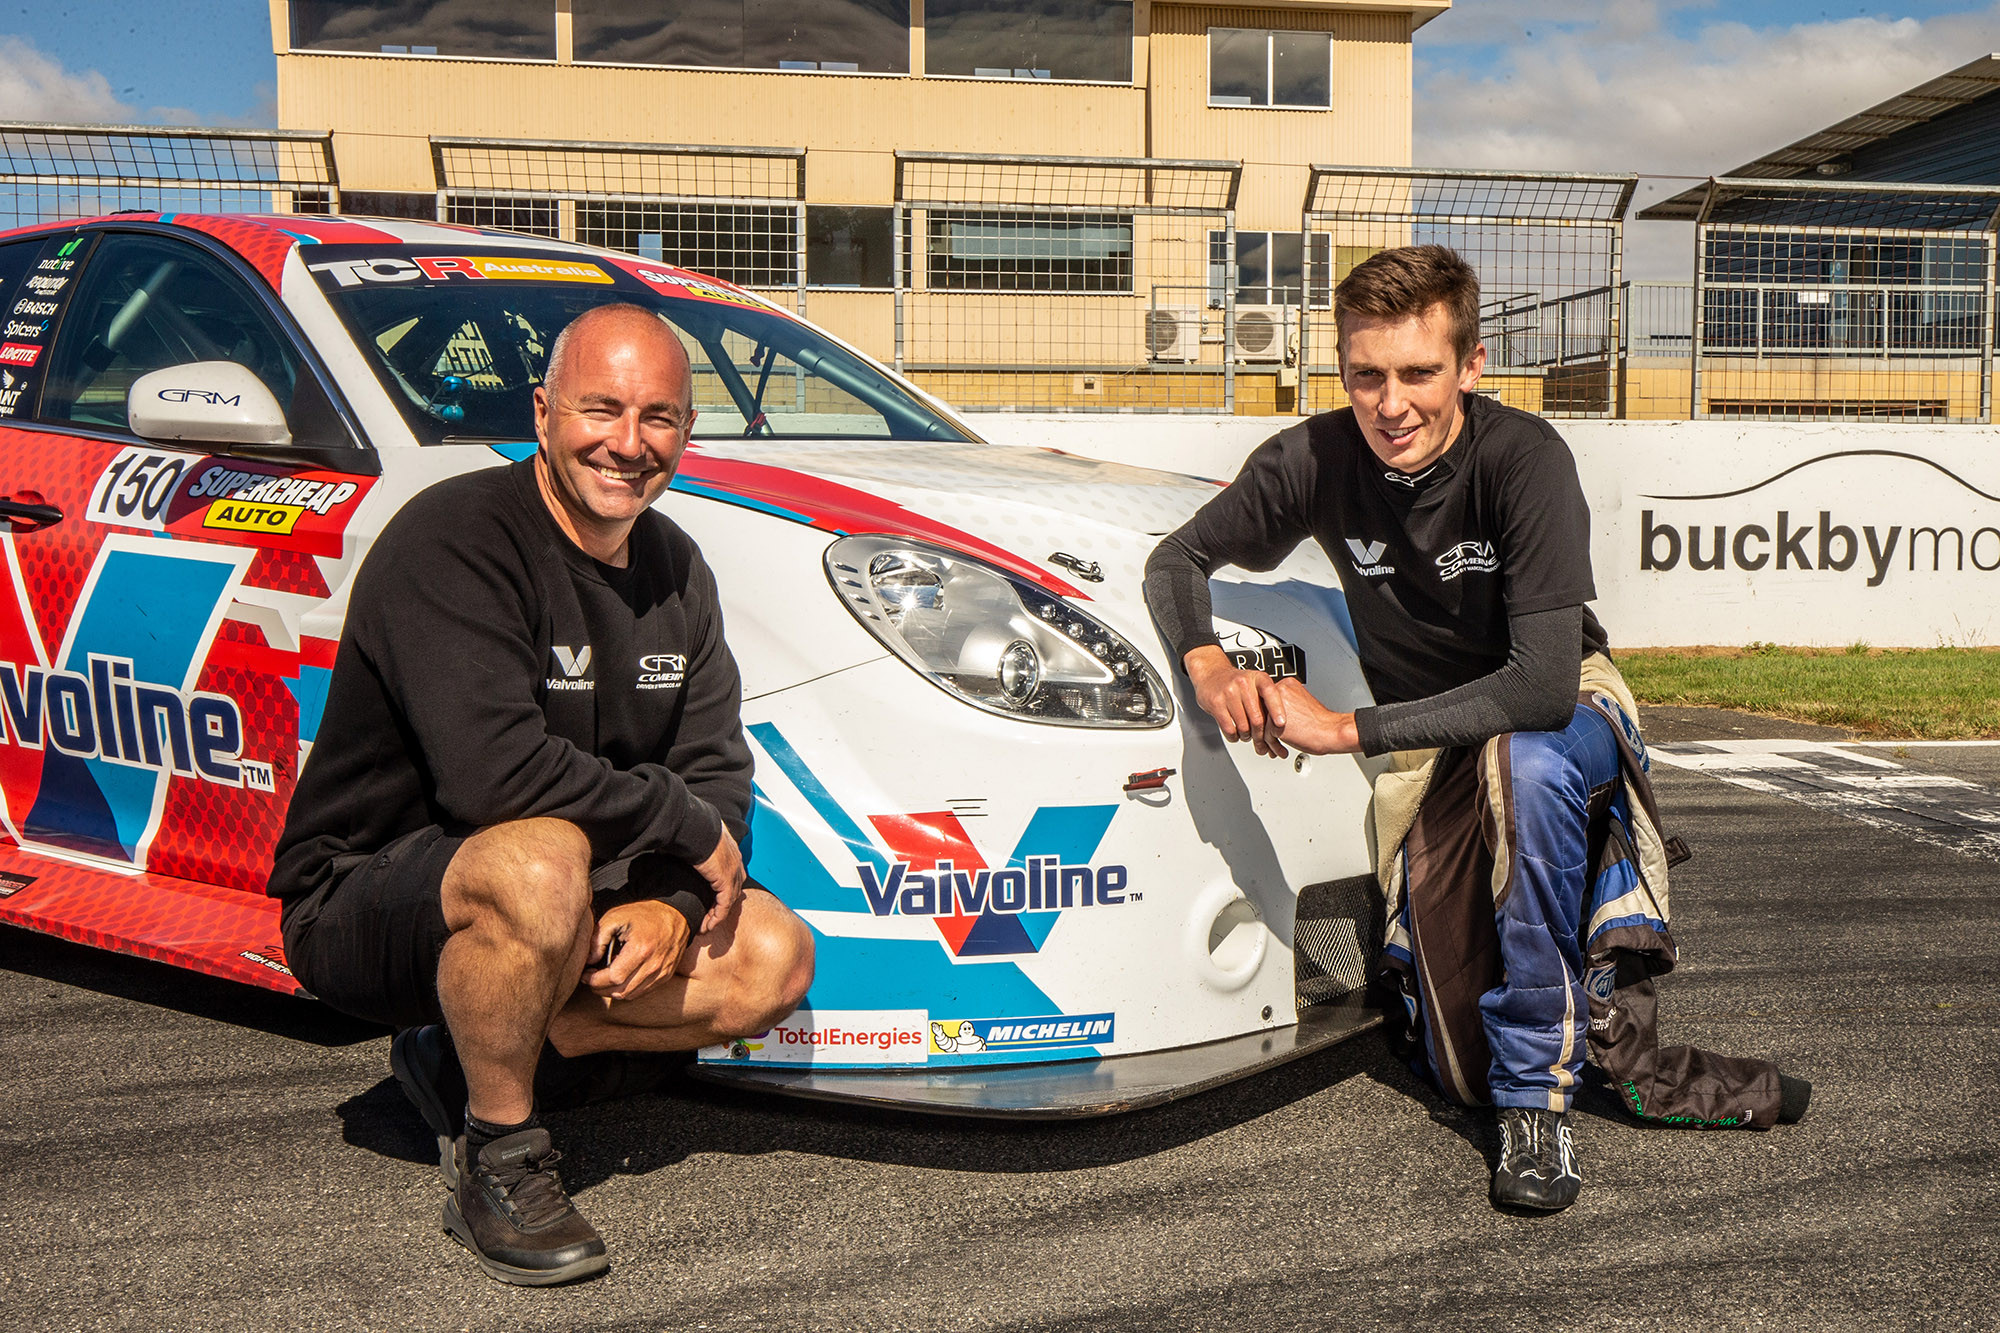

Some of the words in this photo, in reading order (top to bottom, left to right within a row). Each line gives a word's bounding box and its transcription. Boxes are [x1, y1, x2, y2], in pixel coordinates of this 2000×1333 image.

[308, 256, 488, 287] TCR
[484, 261, 601, 278] Australia
[23, 301, 59, 315] BOSCH
[702, 290, 762, 308] AUTO
[4, 320, 42, 338] Spicers
[0, 346, 38, 362] LOCTITE
[158, 388, 241, 407] GRM
[97, 453, 186, 521] 150
[188, 465, 359, 515] SUPERCHEAP
[216, 506, 288, 526] AUTO
[1435, 540, 1495, 567] GRM
[1640, 509, 2000, 587] buckbymo
[1439, 553, 1499, 577] COMBINE
[546, 678, 595, 690] Valvoline
[0, 657, 245, 788] voline
[856, 854, 1128, 917] Valvoline
[1129, 892, 1143, 902] TM
[240, 951, 268, 964] HIGH
[775, 1026, 923, 1050] TotalEnergies
[986, 1019, 1113, 1042] MICHELIN
